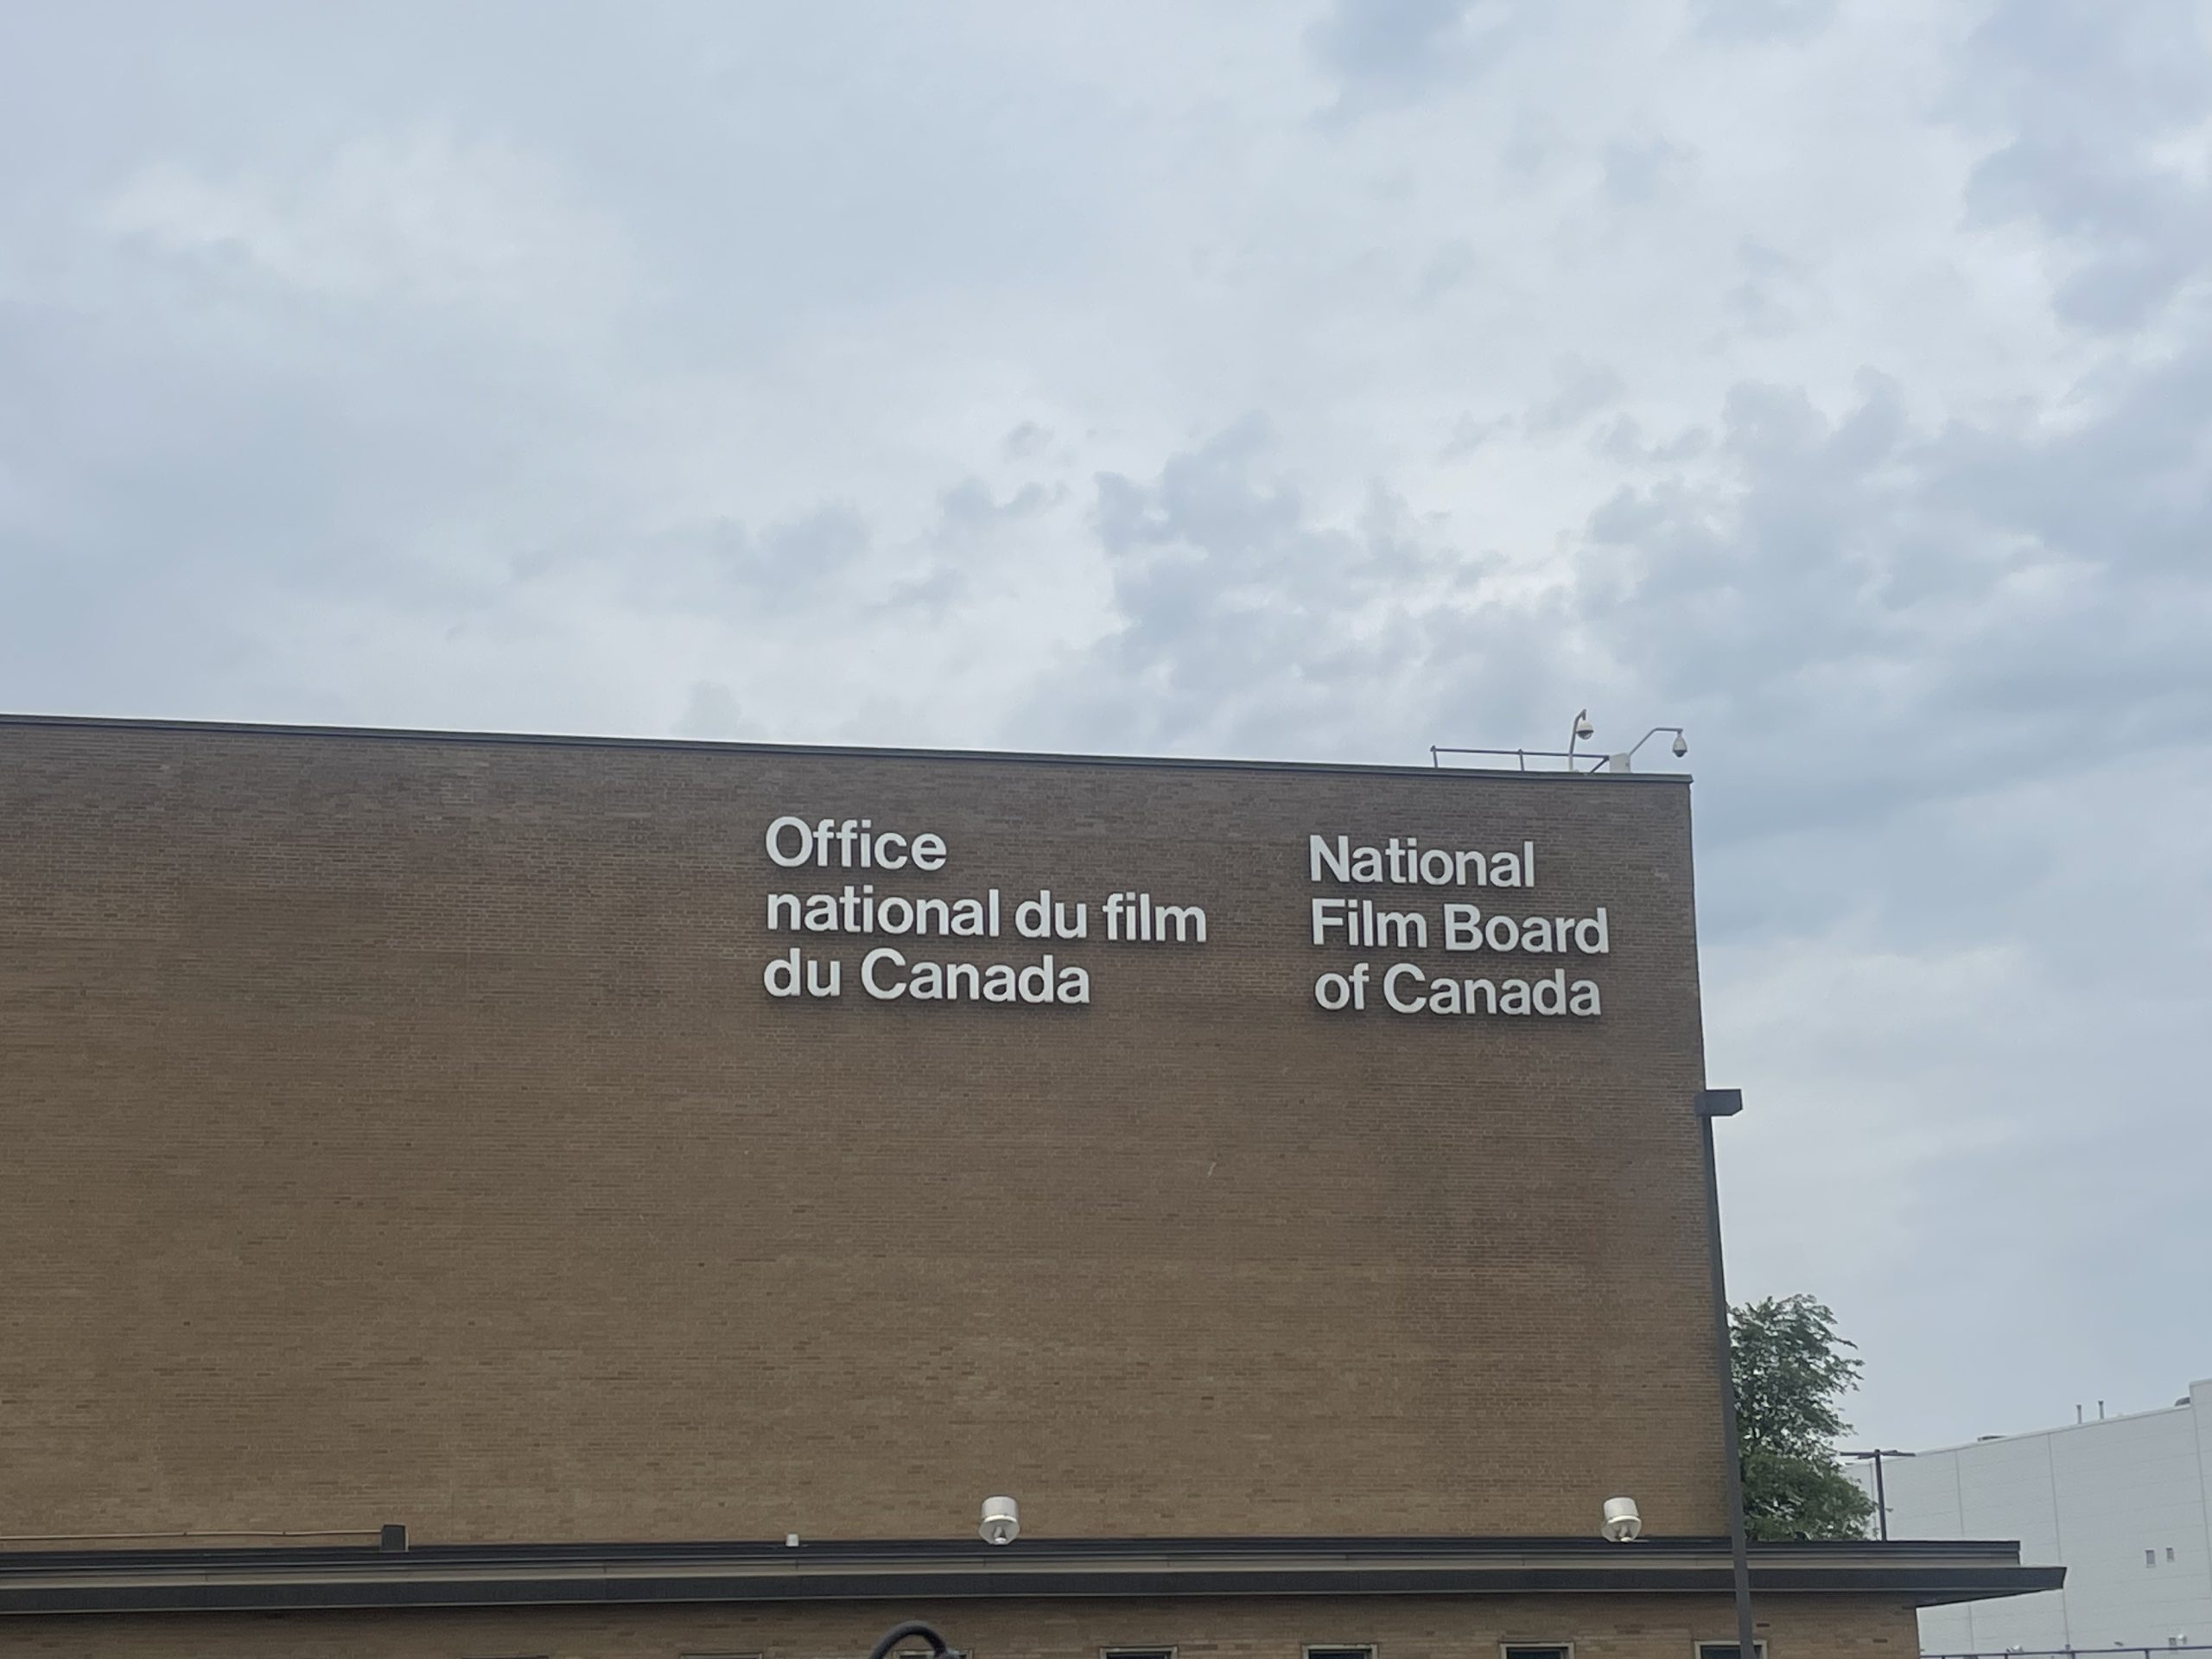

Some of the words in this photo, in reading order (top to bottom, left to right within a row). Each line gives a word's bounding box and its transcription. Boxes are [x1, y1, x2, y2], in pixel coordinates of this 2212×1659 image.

[765, 817, 947, 871] Office
[1309, 835, 1535, 887] National
[766, 885, 1000, 938] national
[1015, 890, 1088, 939] du
[1102, 892, 1207, 943] film
[1311, 898, 1427, 949] Film
[1443, 904, 1610, 954] Board
[763, 948, 841, 997] du
[861, 948, 1090, 1005] Canada
[1314, 963, 1370, 1011] of
[1382, 963, 1602, 1016] Canada
